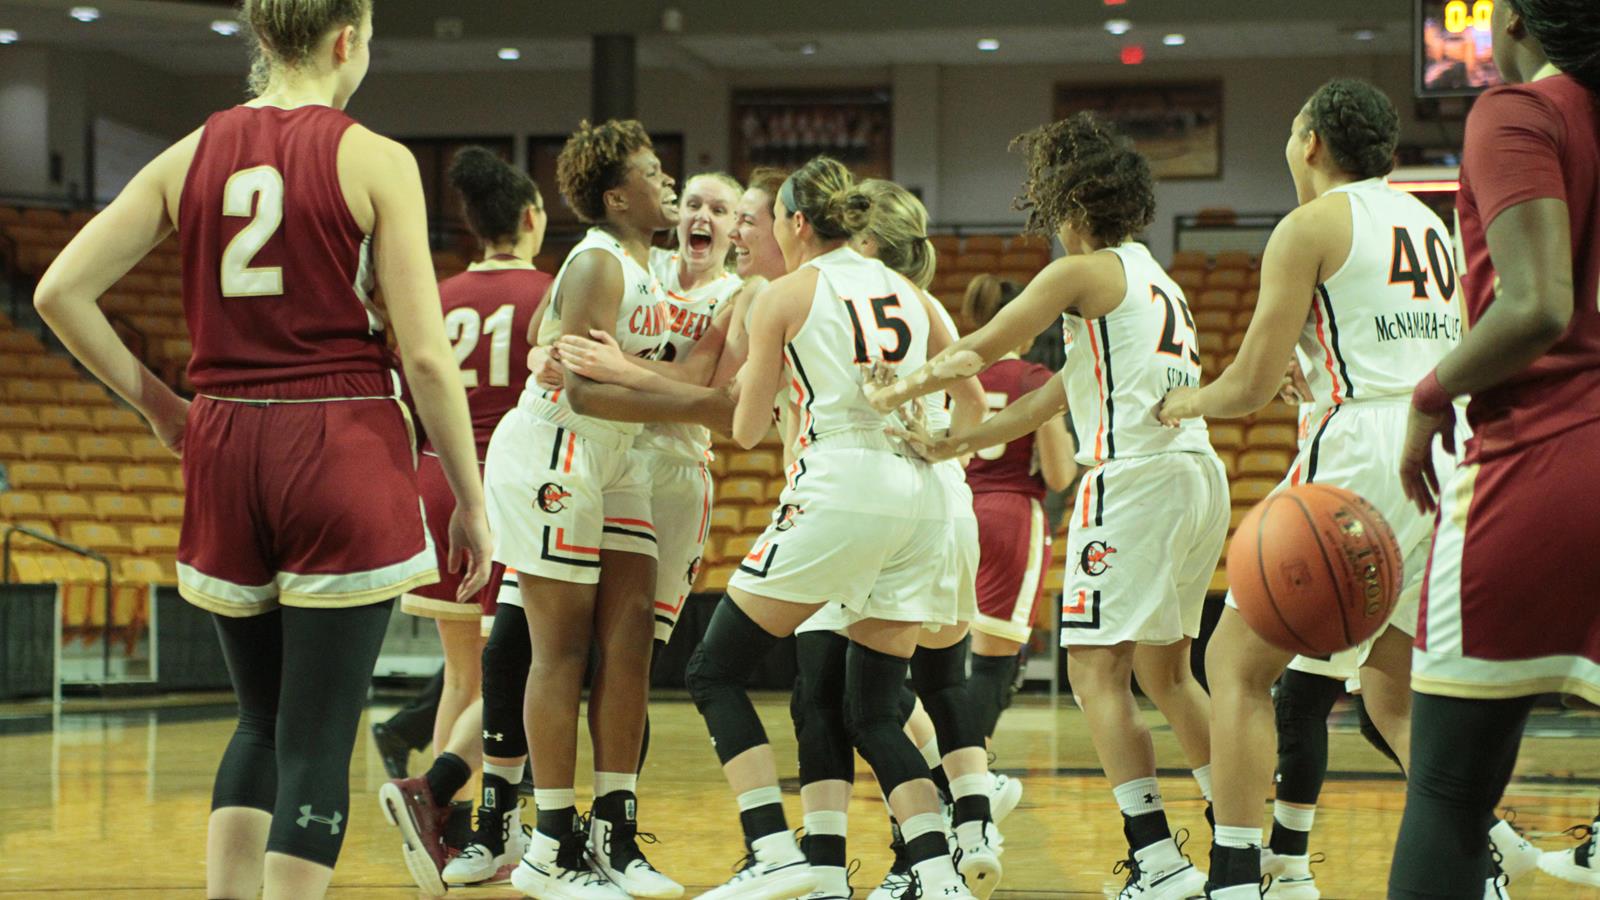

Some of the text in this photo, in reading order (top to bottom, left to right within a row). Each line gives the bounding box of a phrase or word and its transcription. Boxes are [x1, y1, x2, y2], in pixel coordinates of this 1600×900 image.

[221, 165, 284, 297] 2
[1388, 225, 1456, 304] 40
[444, 303, 515, 388] 21
[838, 292, 912, 364] 15
[1150, 284, 1200, 368] 25
